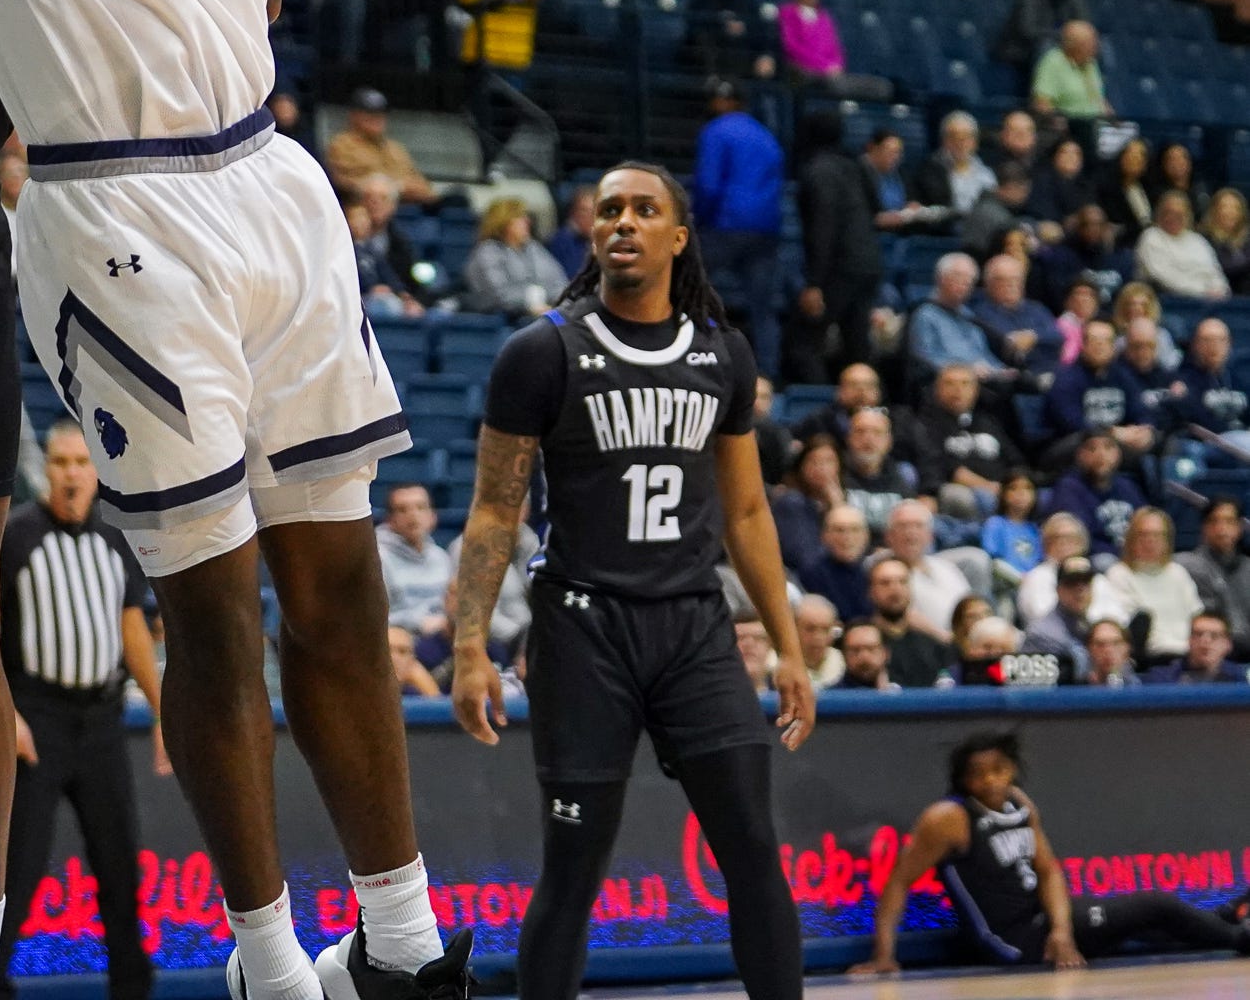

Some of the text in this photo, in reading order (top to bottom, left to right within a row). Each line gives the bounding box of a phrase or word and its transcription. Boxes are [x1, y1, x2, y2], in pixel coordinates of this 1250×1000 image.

[685, 352, 719, 367] CAA
[584, 387, 719, 453] HAMPTON
[621, 464, 684, 542] 12
[1000, 654, 1060, 685] POSS
[1056, 850, 1235, 898] TONTOWN
